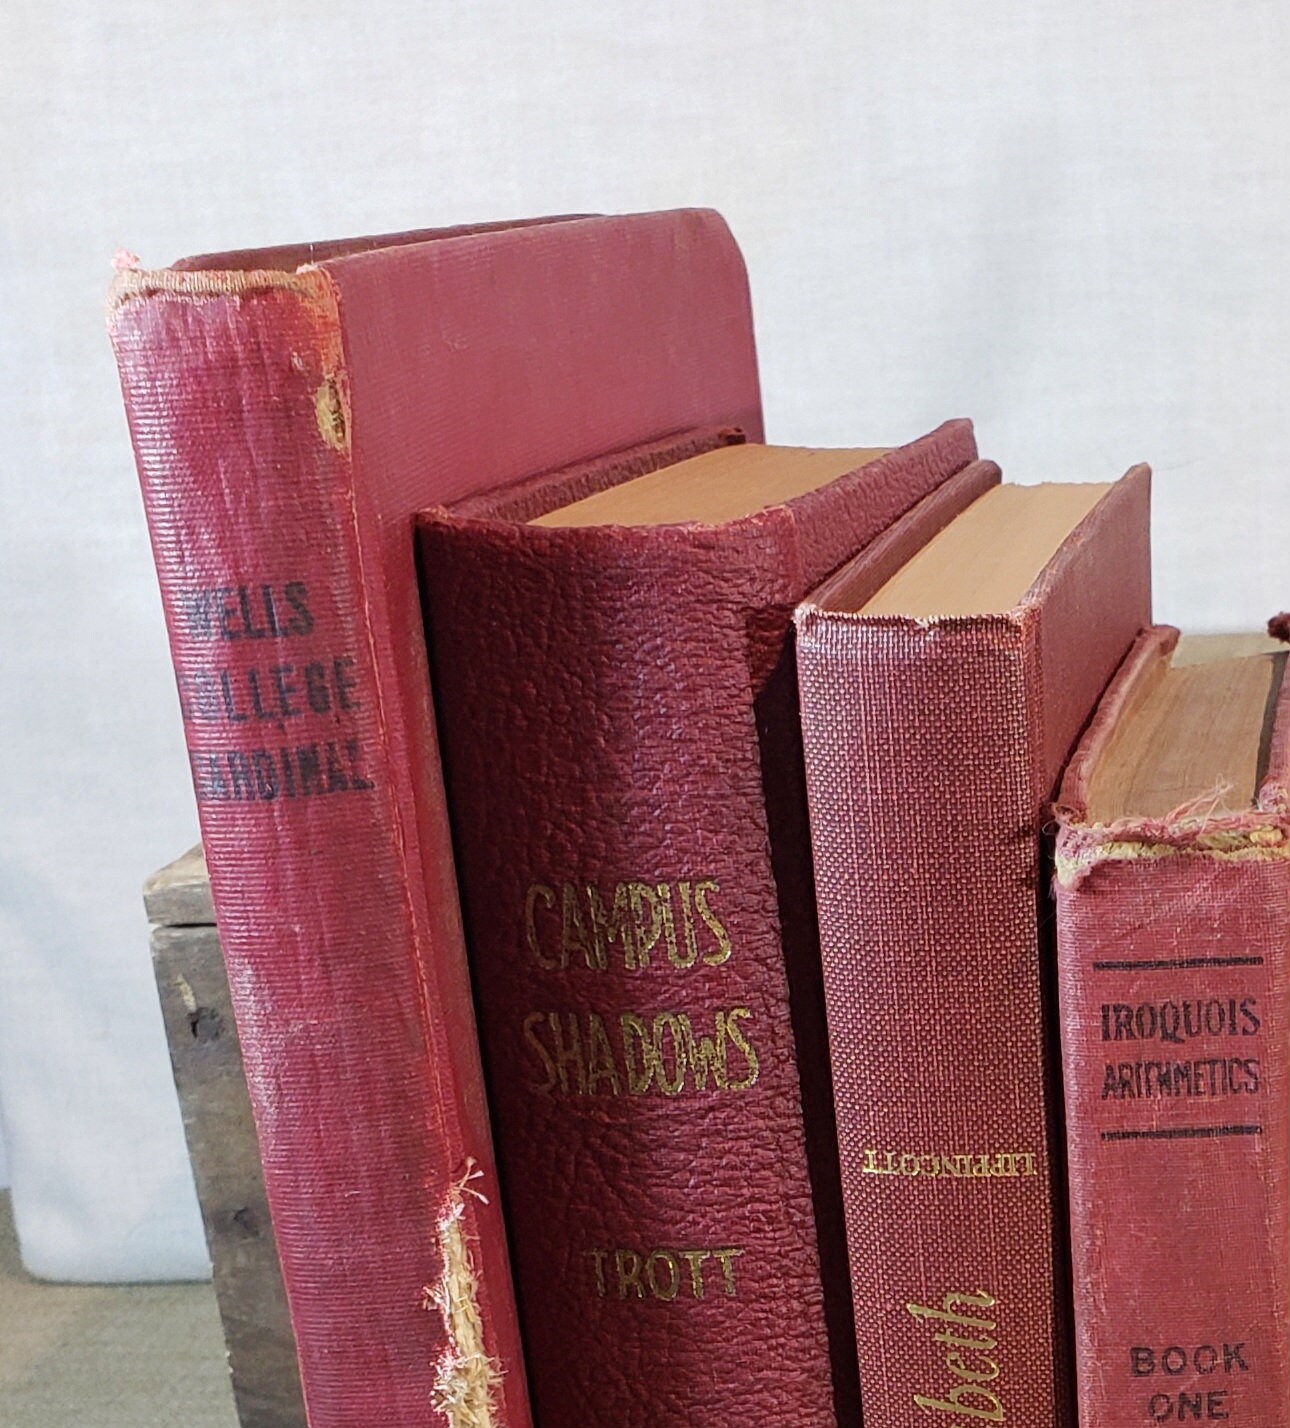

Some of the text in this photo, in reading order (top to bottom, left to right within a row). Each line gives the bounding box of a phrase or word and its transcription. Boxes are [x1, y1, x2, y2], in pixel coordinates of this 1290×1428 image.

[525, 880, 732, 971] CAMPUS
[1101, 998, 1261, 1044] IROQUOIS
[523, 1007, 761, 1097] SHADOWS
[1101, 1057, 1261, 1101] ARITHMETICS
[862, 1148, 1038, 1178] LIPPINCOTT
[587, 1247, 748, 1301] TROTT
[1130, 1342, 1249, 1378] BOOK
[1149, 1390, 1230, 1423] ONE
